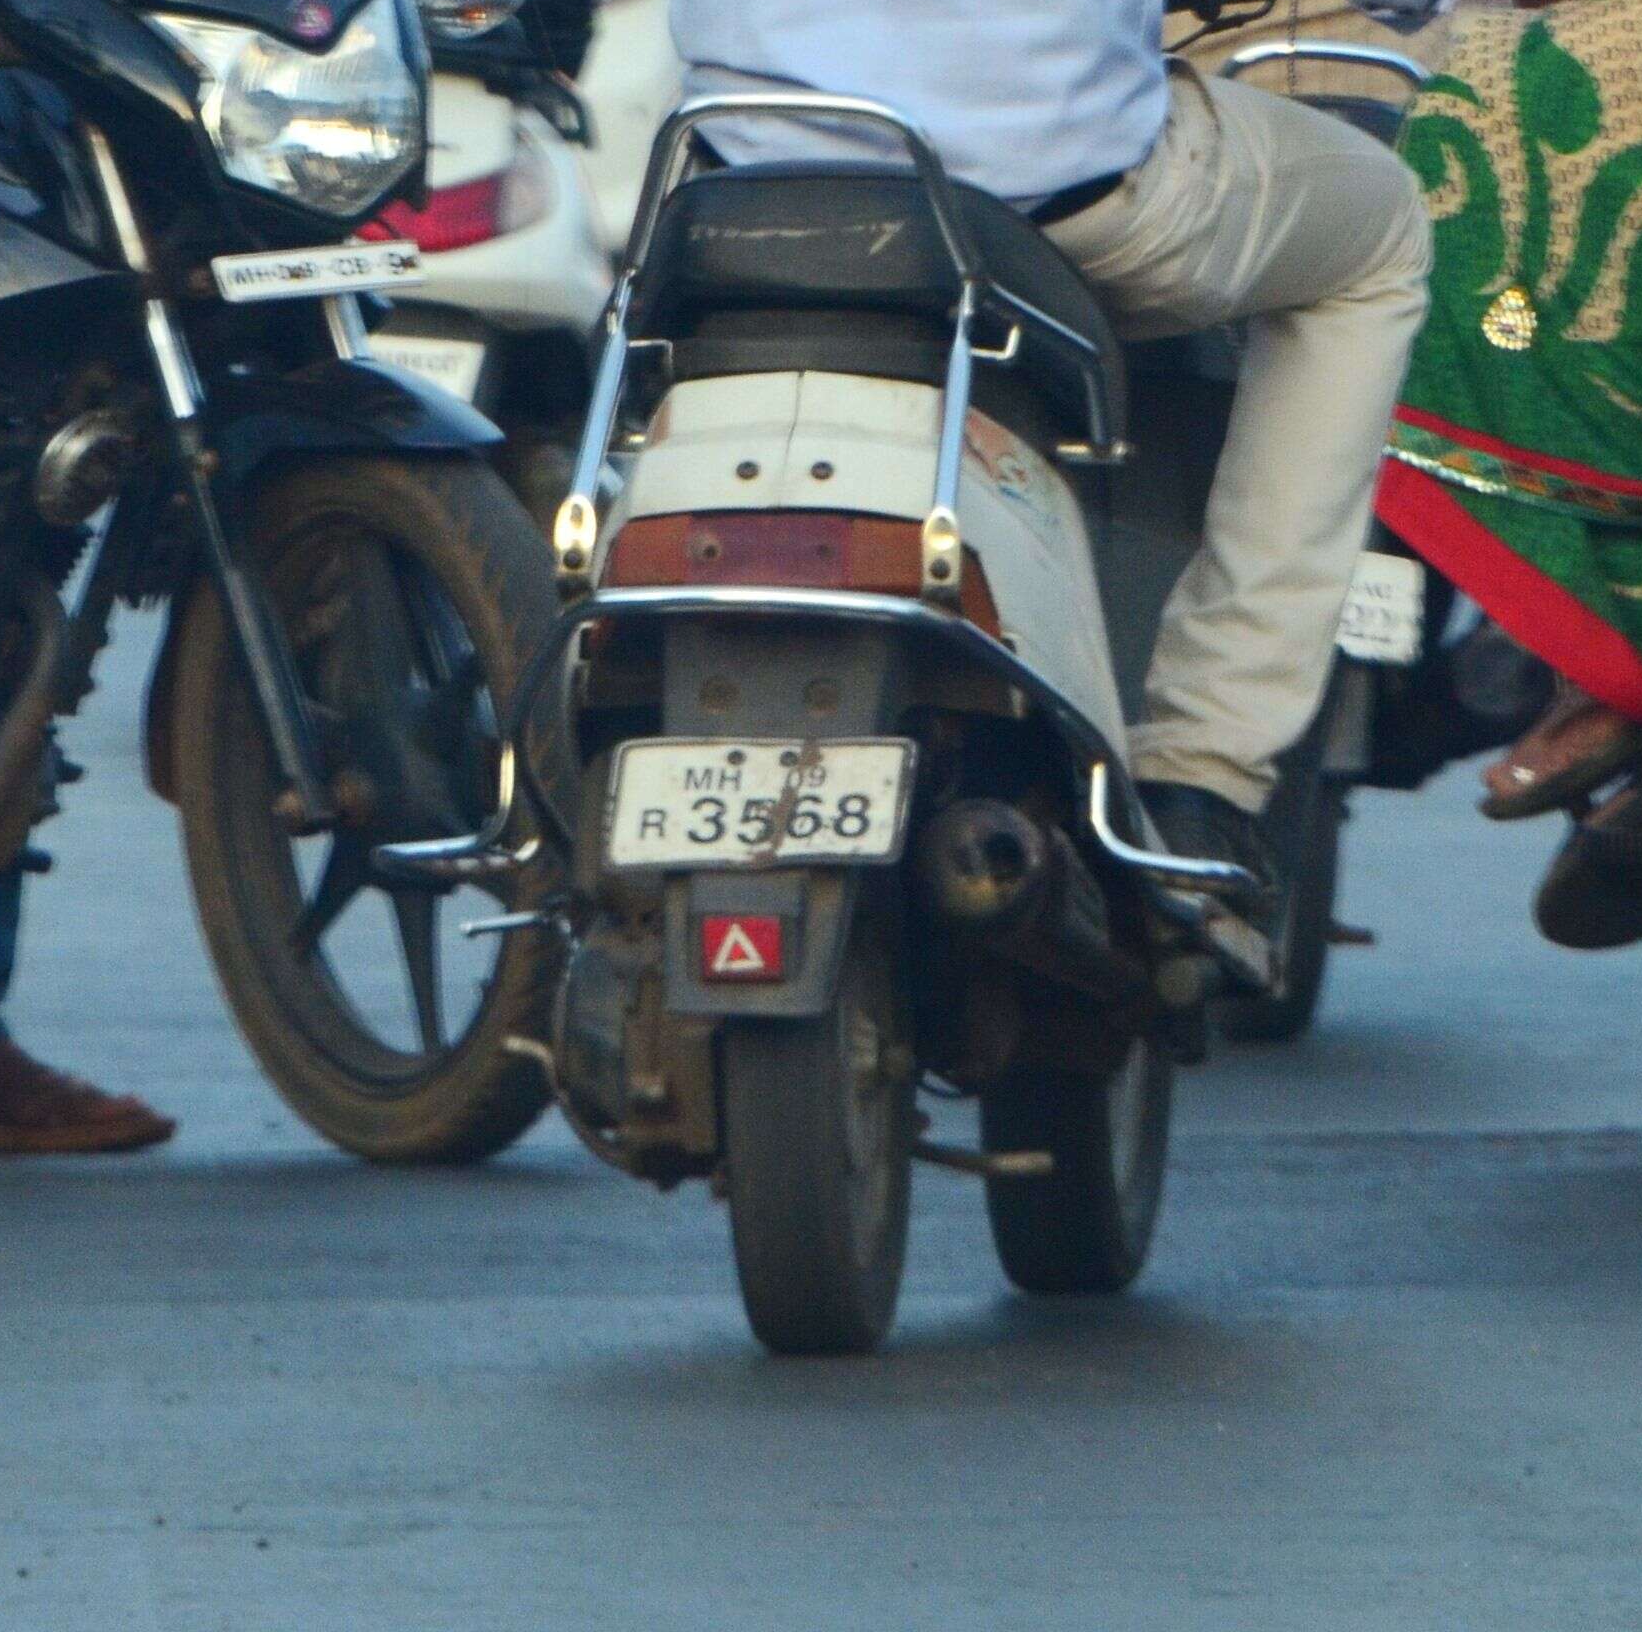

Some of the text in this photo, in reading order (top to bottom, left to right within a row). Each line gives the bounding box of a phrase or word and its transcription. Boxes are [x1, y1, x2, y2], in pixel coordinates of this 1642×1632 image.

[685, 767, 827, 792] MH 09
[639, 794, 871, 846] R 3568
